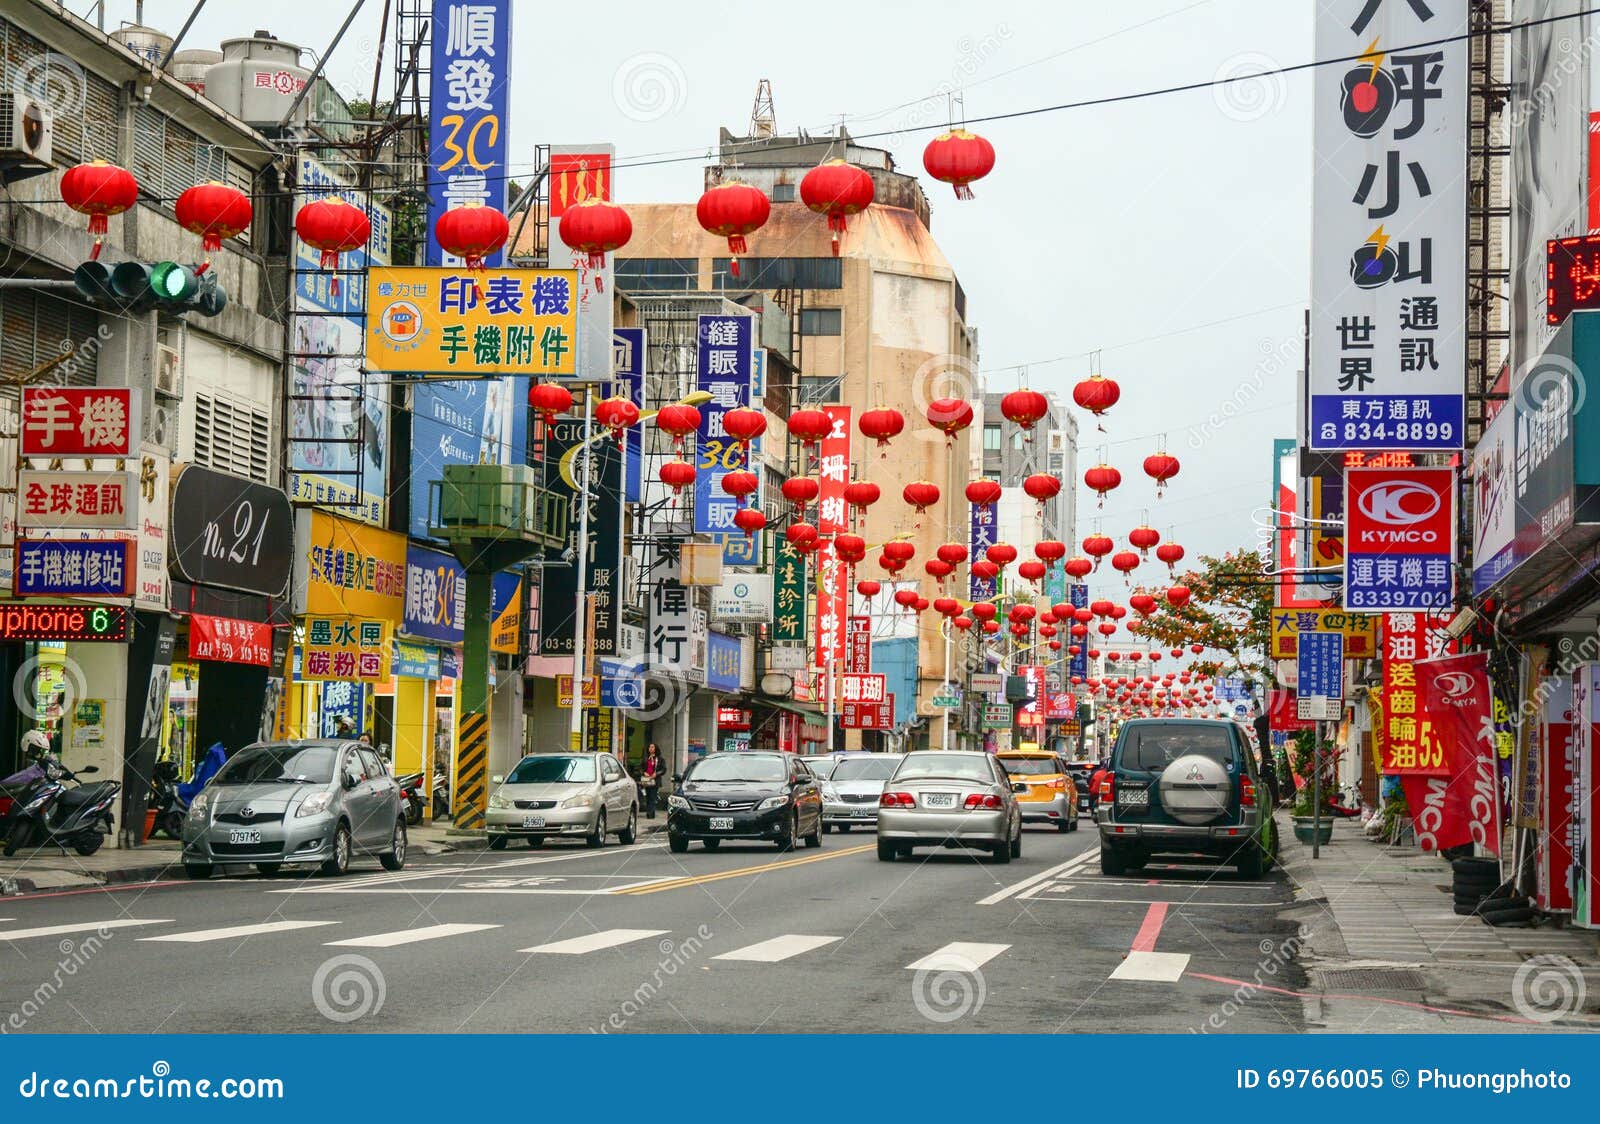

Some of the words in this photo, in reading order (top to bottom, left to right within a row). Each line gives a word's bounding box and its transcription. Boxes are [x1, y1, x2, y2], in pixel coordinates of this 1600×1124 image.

[439, 275, 570, 316] 印表機
[439, 325, 569, 367] 手機附件
[1399, 296, 1439, 372] 通訊
[1336, 315, 1376, 392] 世界
[26, 395, 126, 448] 手機
[1342, 399, 1432, 421] 東方通訊
[1343, 422, 1453, 441] 834-8899
[25, 482, 124, 516] 全球通訊
[1361, 530, 1438, 543] KYMCO
[22, 549, 122, 587] 手機維修站
[1351, 558, 1448, 588] 運東機車
[92, 607, 110, 632] 6
[308, 619, 383, 647] 墨水匣
[307, 650, 381, 678] 碳粉匣
